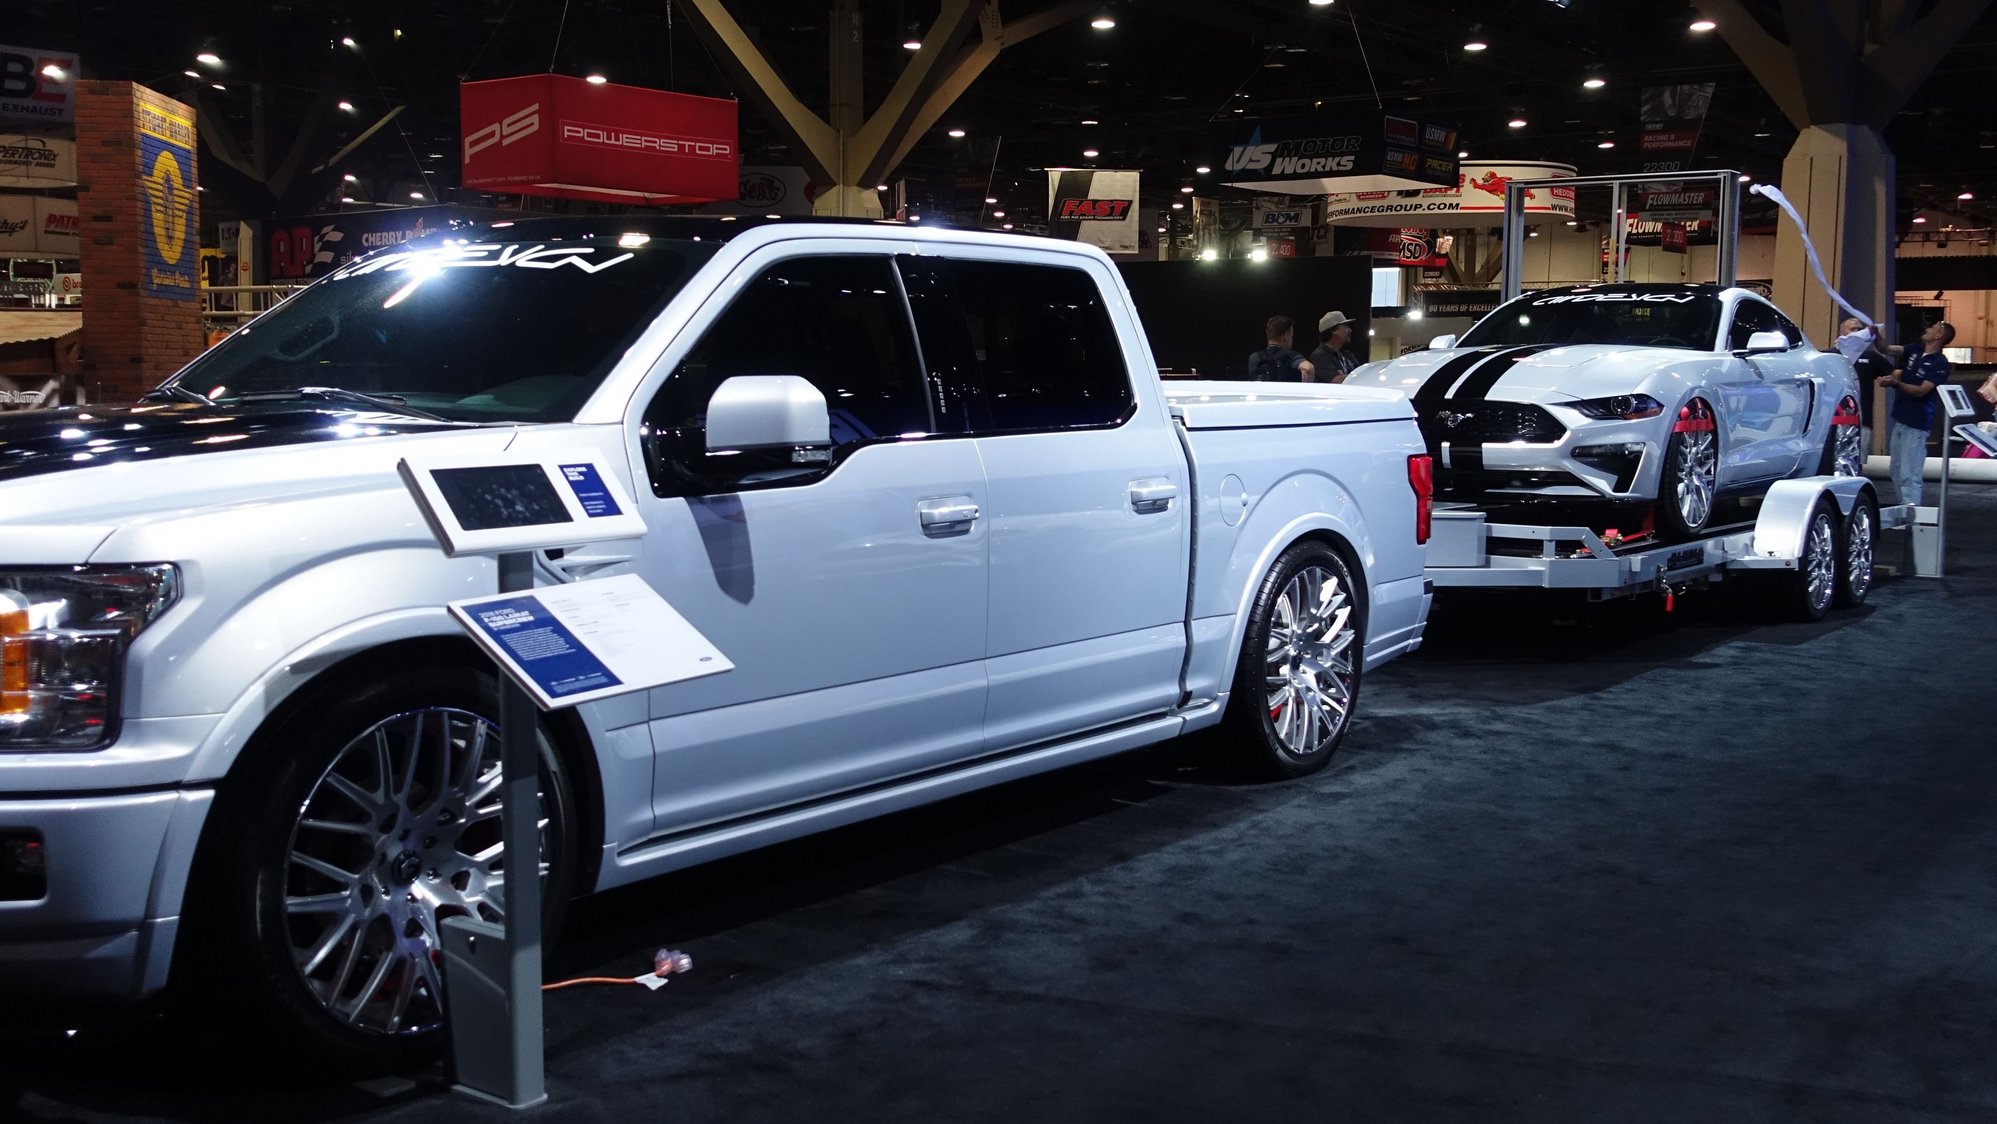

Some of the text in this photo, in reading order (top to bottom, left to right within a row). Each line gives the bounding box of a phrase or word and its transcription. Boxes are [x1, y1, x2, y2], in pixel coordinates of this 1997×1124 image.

[2, 103, 65, 117] EXHAUST
[464, 102, 540, 165] PS
[564, 125, 731, 156] POWERSTOP
[1224, 143, 1281, 171] US
[1278, 136, 1362, 156] MOTOR
[1271, 155, 1356, 175] WORKS
[1642, 161, 1681, 173] 22300
[1061, 200, 1127, 216] FAST
[1645, 192, 1705, 210] FLOWMASTER
[361, 230, 402, 248] CHERRY
